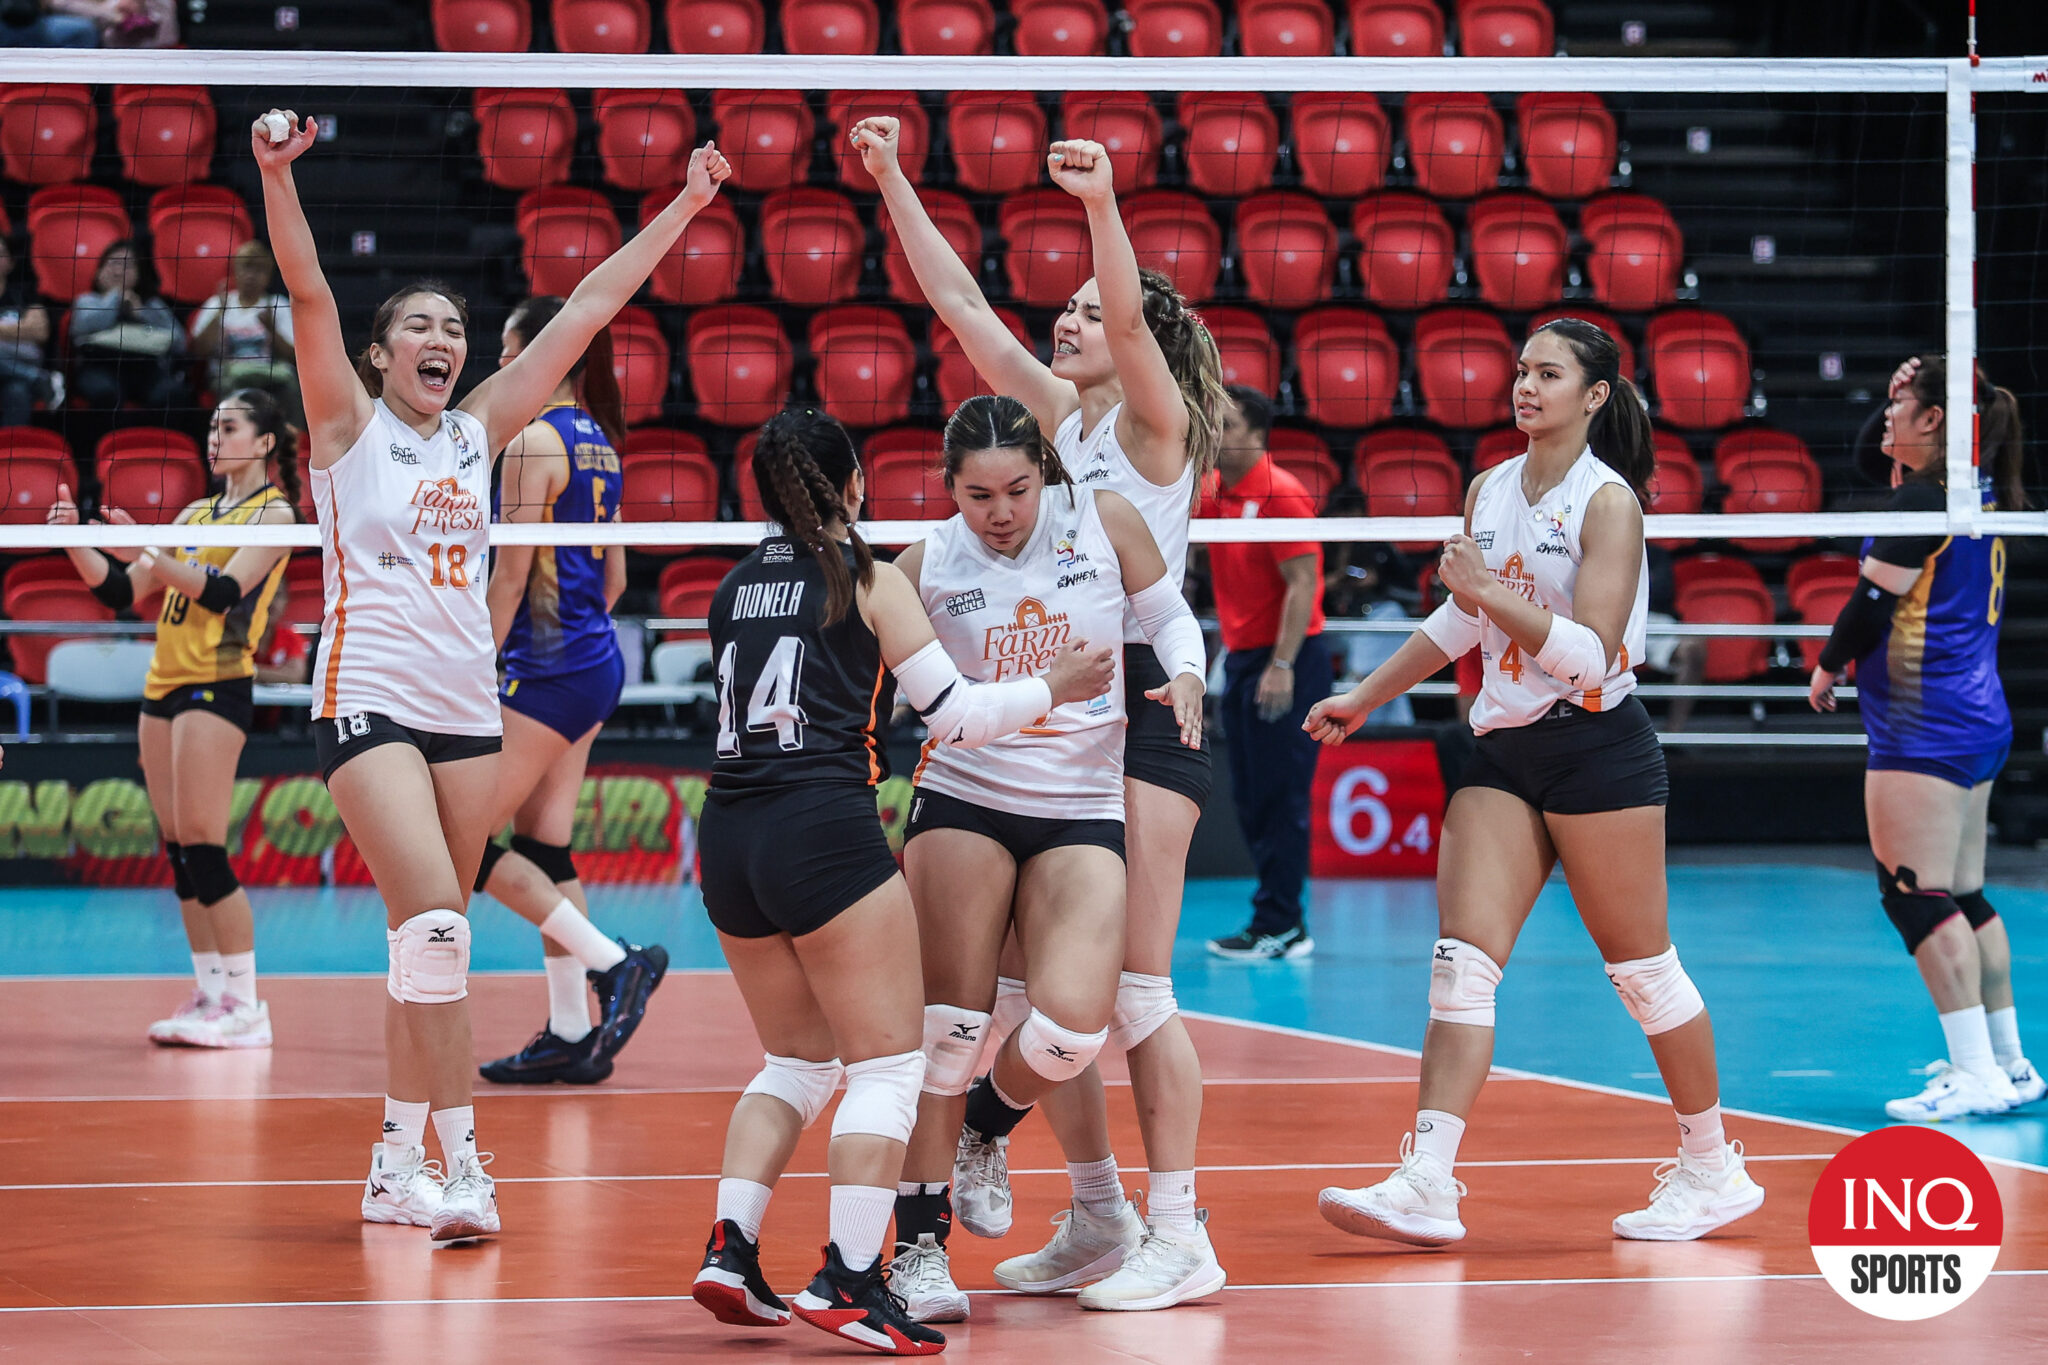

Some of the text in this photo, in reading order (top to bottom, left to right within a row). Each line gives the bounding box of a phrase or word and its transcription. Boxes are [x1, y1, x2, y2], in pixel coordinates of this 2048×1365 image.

[427, 543, 470, 590] 18
[1076, 553, 1089, 563] PVL
[946, 588, 985, 608] GAME
[1987, 537, 2006, 627] 8
[163, 591, 190, 626] 19
[732, 581, 805, 621] DIONELA
[947, 600, 986, 617] VILLE
[1499, 639, 1524, 685] 4
[716, 636, 808, 759] 14
[334, 712, 371, 744] 18
